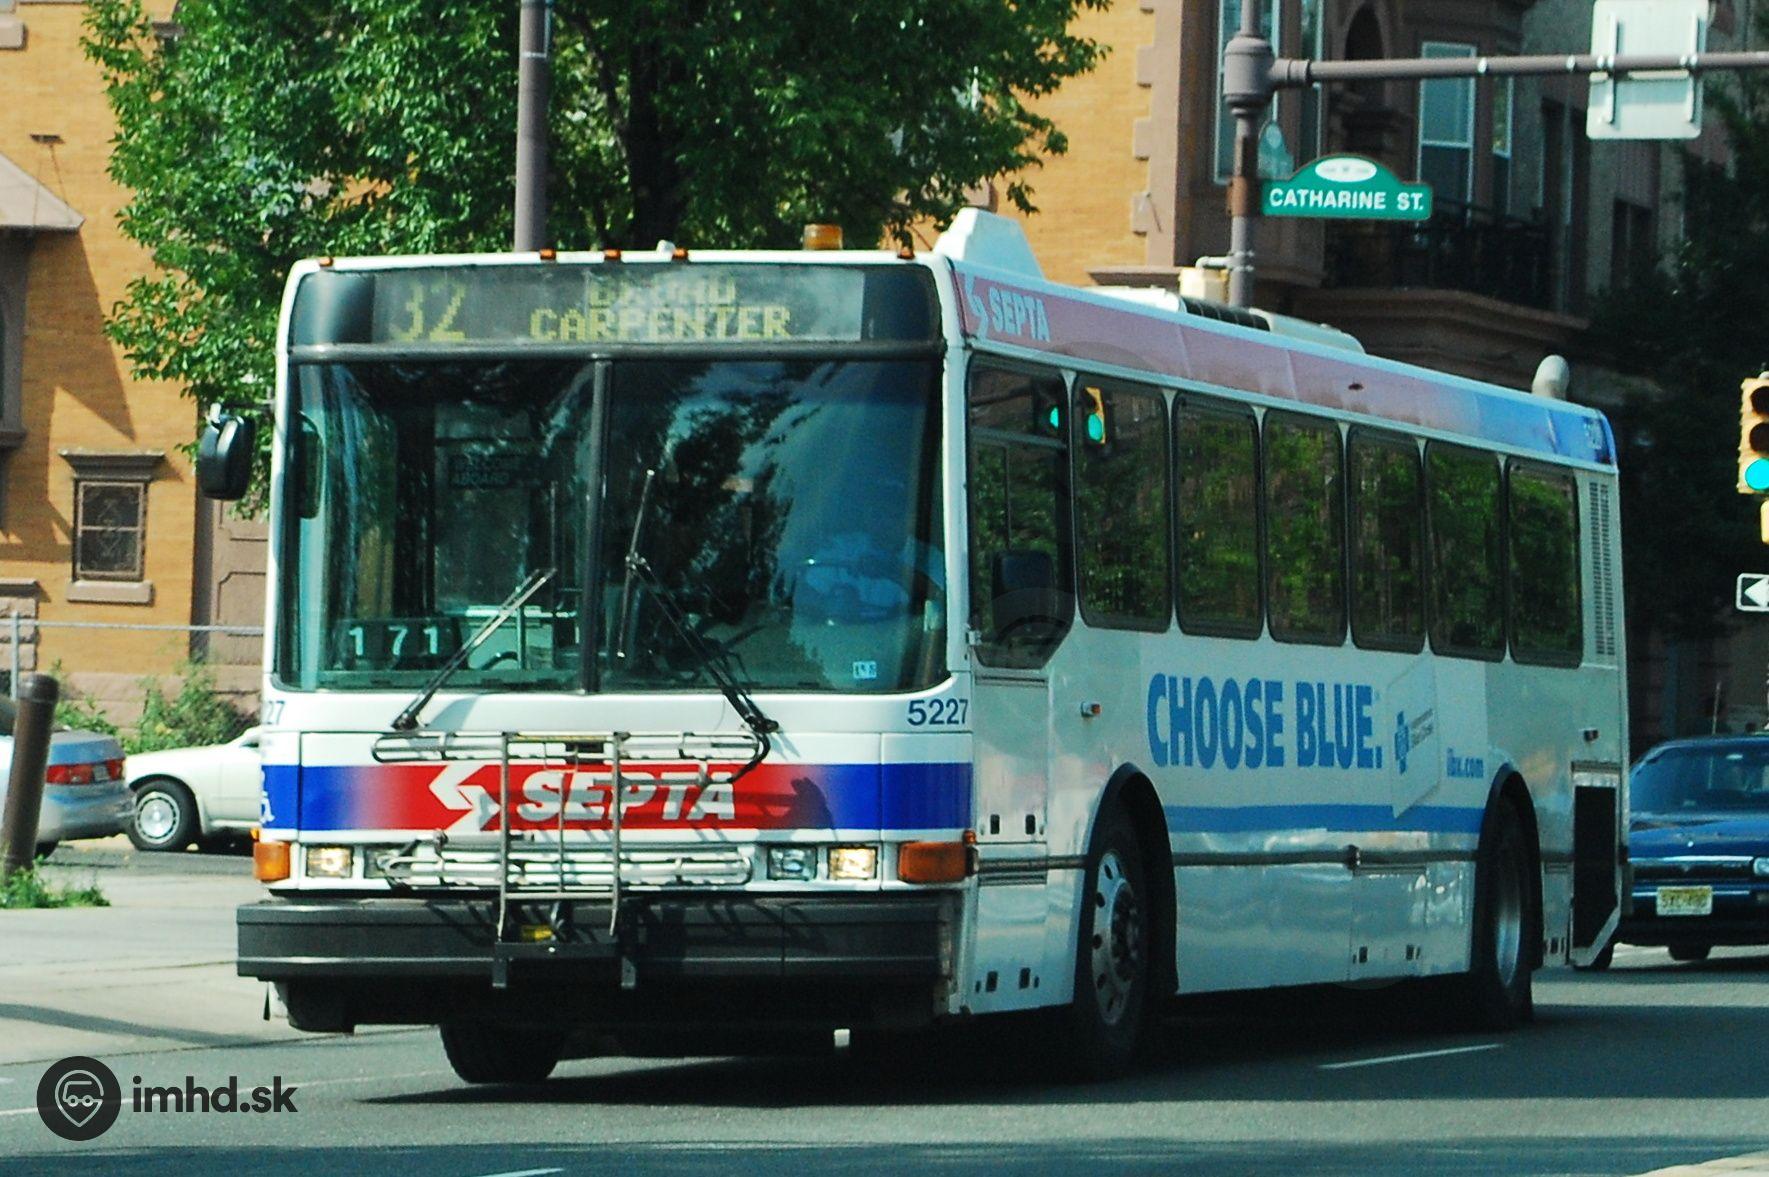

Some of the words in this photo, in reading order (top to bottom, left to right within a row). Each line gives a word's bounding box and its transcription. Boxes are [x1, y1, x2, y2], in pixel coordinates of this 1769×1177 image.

[1269, 188, 1386, 210] CATHARINE
[1397, 192, 1424, 211] ST.
[528, 306, 792, 342] CARPENTER
[989, 286, 1051, 343] SEPTA
[907, 698, 968, 726] 5227
[1147, 672, 1285, 770] CHOOSE
[1296, 681, 1383, 770] BLUE.
[516, 770, 736, 822] SEPTA
